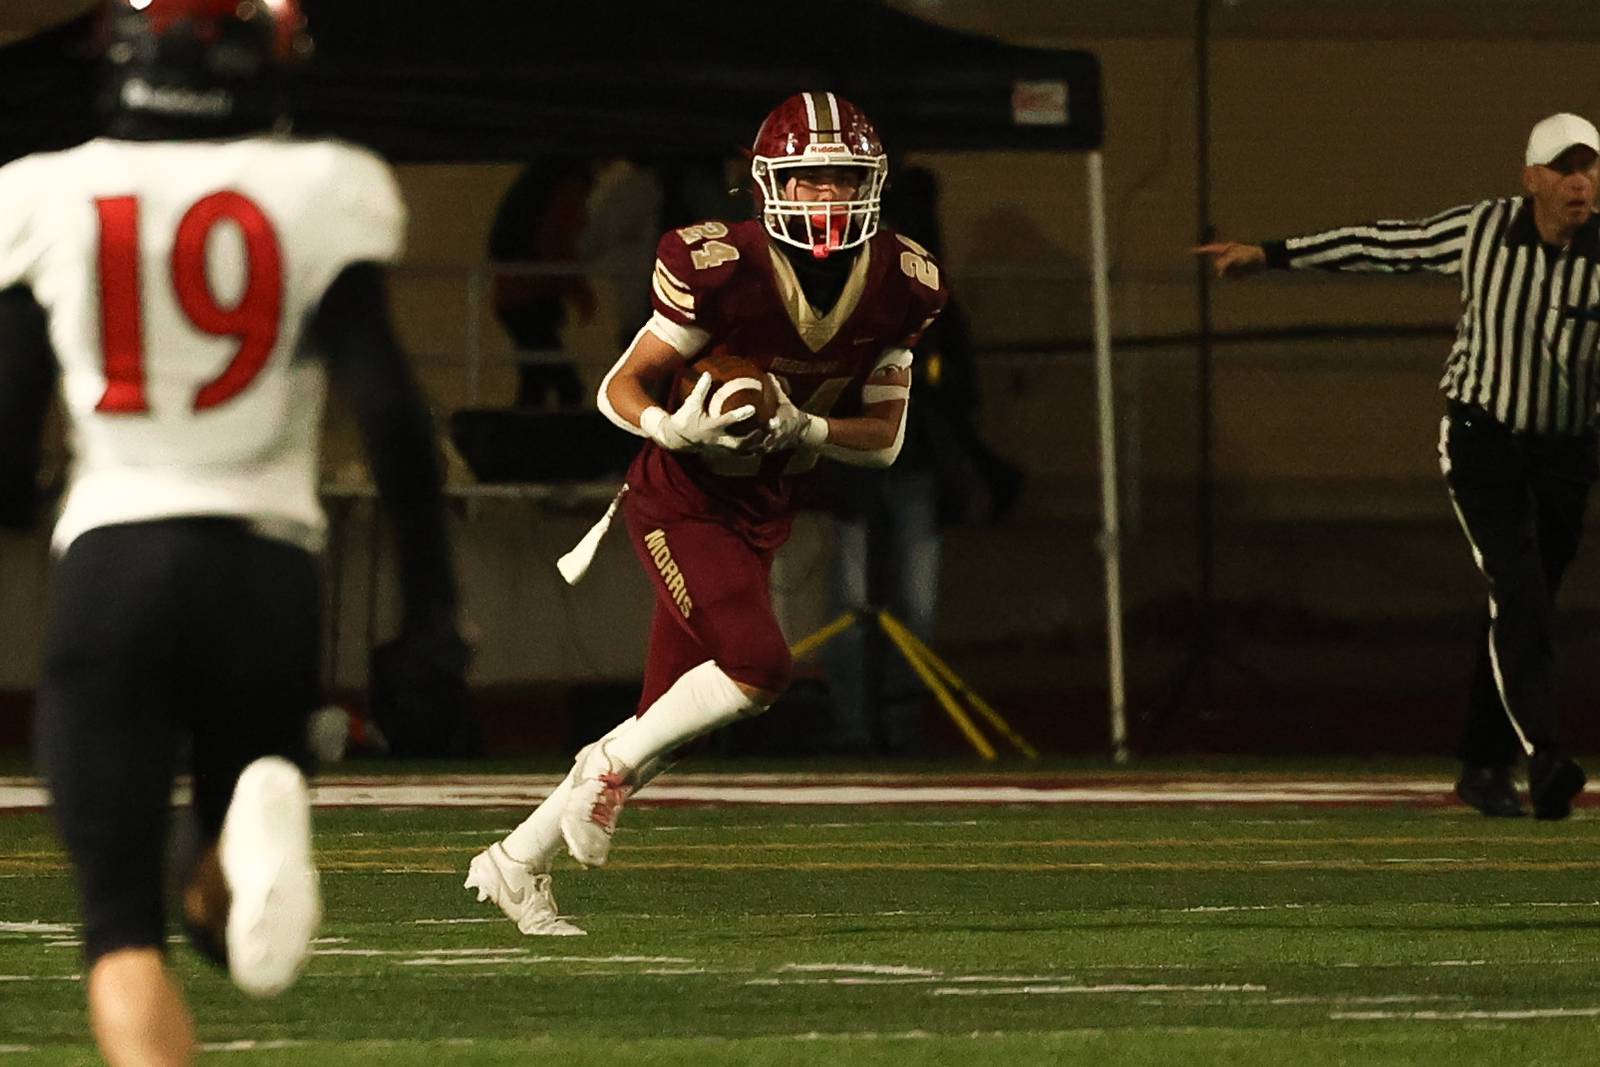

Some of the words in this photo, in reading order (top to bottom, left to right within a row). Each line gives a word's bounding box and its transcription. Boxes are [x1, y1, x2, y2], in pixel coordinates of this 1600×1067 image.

[676, 221, 740, 271] 24
[95, 190, 282, 412] 19
[643, 528, 693, 620] MORRIS
